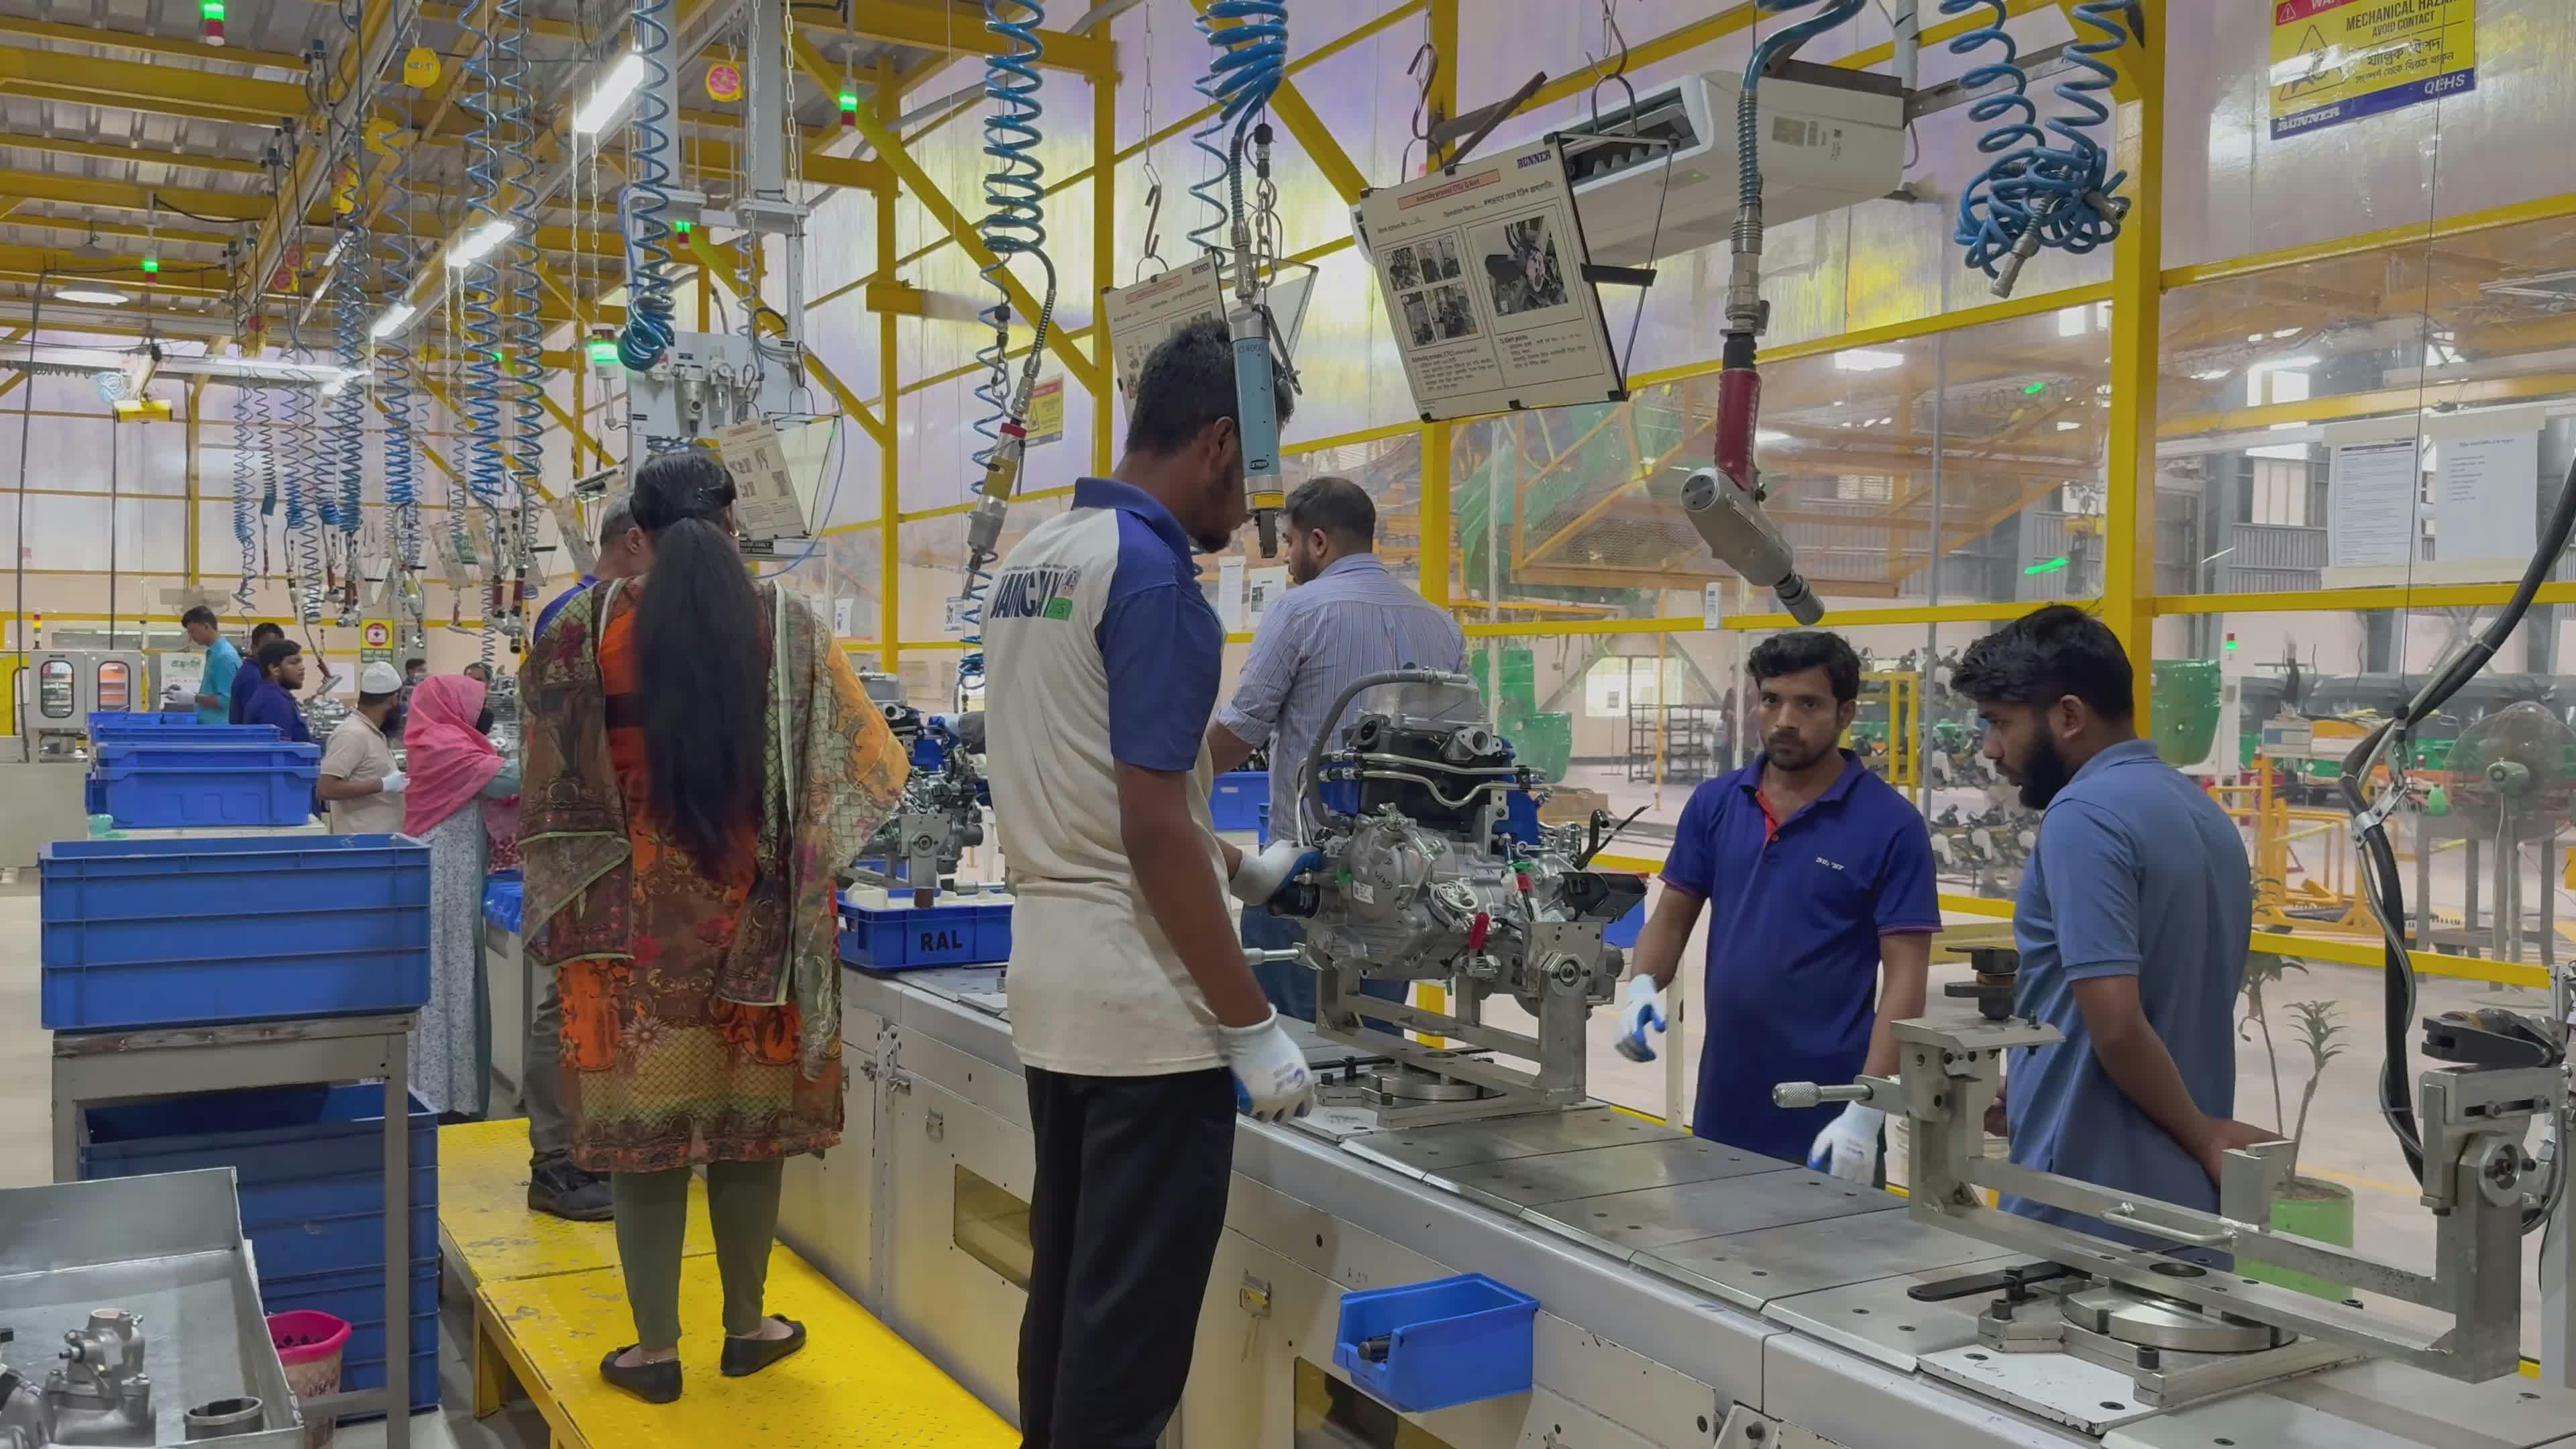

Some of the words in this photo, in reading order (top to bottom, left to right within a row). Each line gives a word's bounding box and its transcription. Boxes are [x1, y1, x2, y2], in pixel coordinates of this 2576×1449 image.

[2346, 0, 2416, 32] MECHANICAL
[2372, 21, 2396, 38] AVOID
[2398, 11, 2435, 32] CONTACT
[2424, 73, 2465, 95] QEHS
[1517, 150, 1552, 168] RUNNER
[920, 930, 963, 951] RAL
